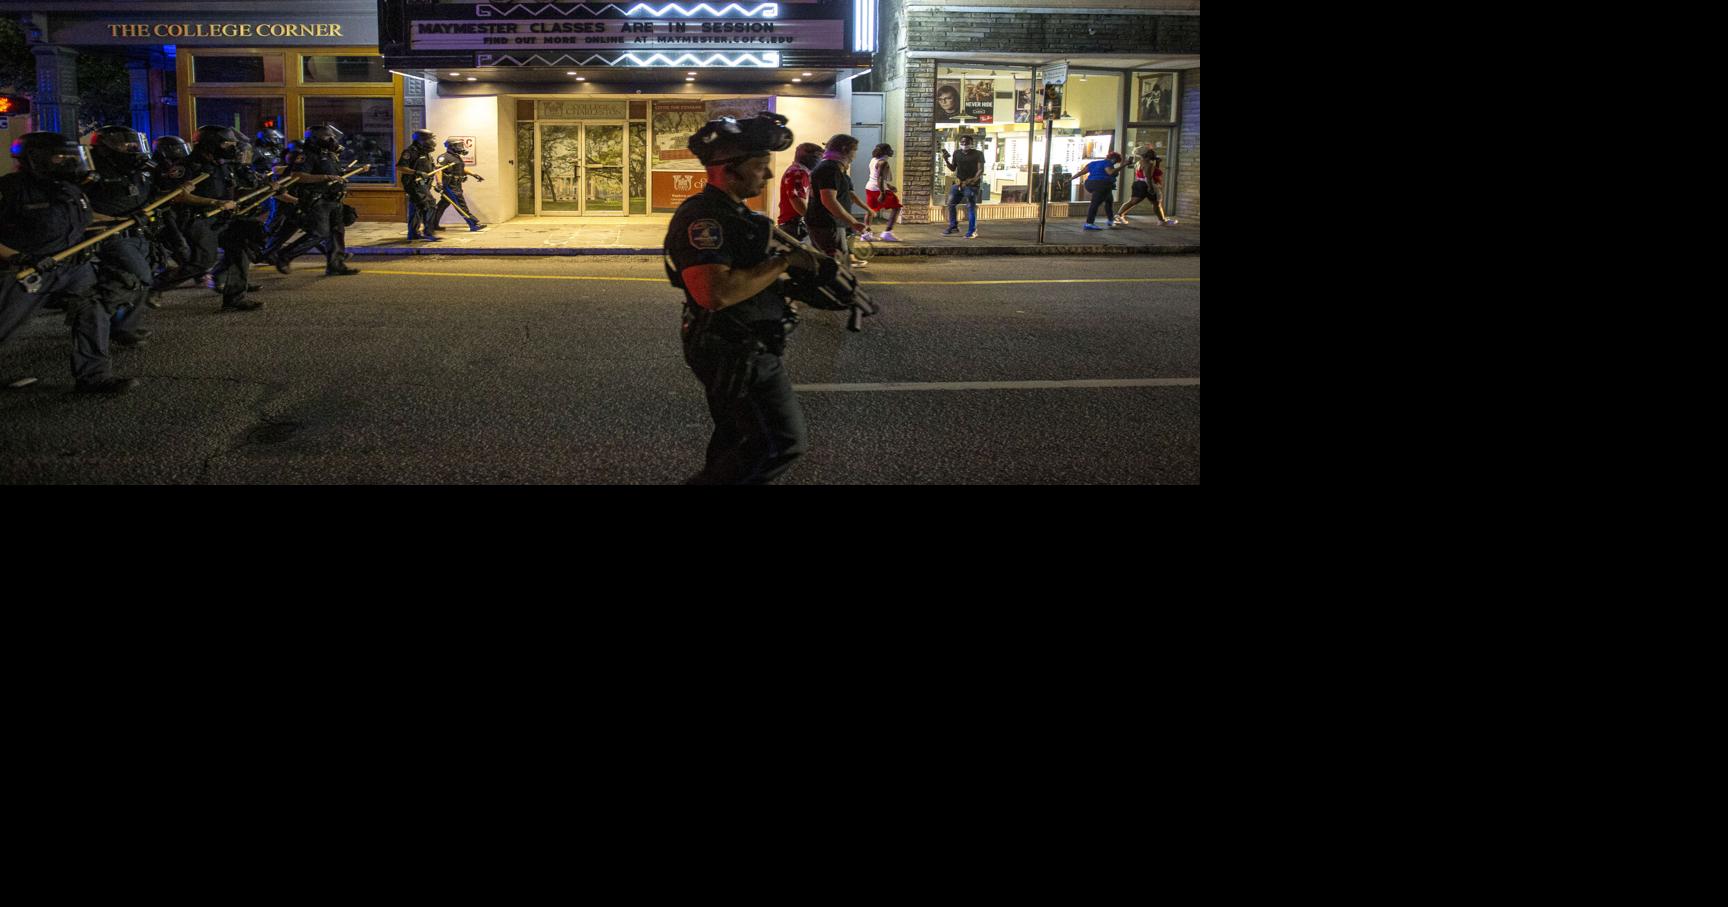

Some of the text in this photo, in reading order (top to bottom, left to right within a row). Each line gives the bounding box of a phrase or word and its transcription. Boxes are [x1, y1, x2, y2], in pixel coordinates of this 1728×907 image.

[108, 23, 343, 37] THE COLLEGE CORNER
[418, 22, 775, 34] MAYMESTER CLASSES ARE IN SESSION
[585, 36, 625, 44] ONLINE
